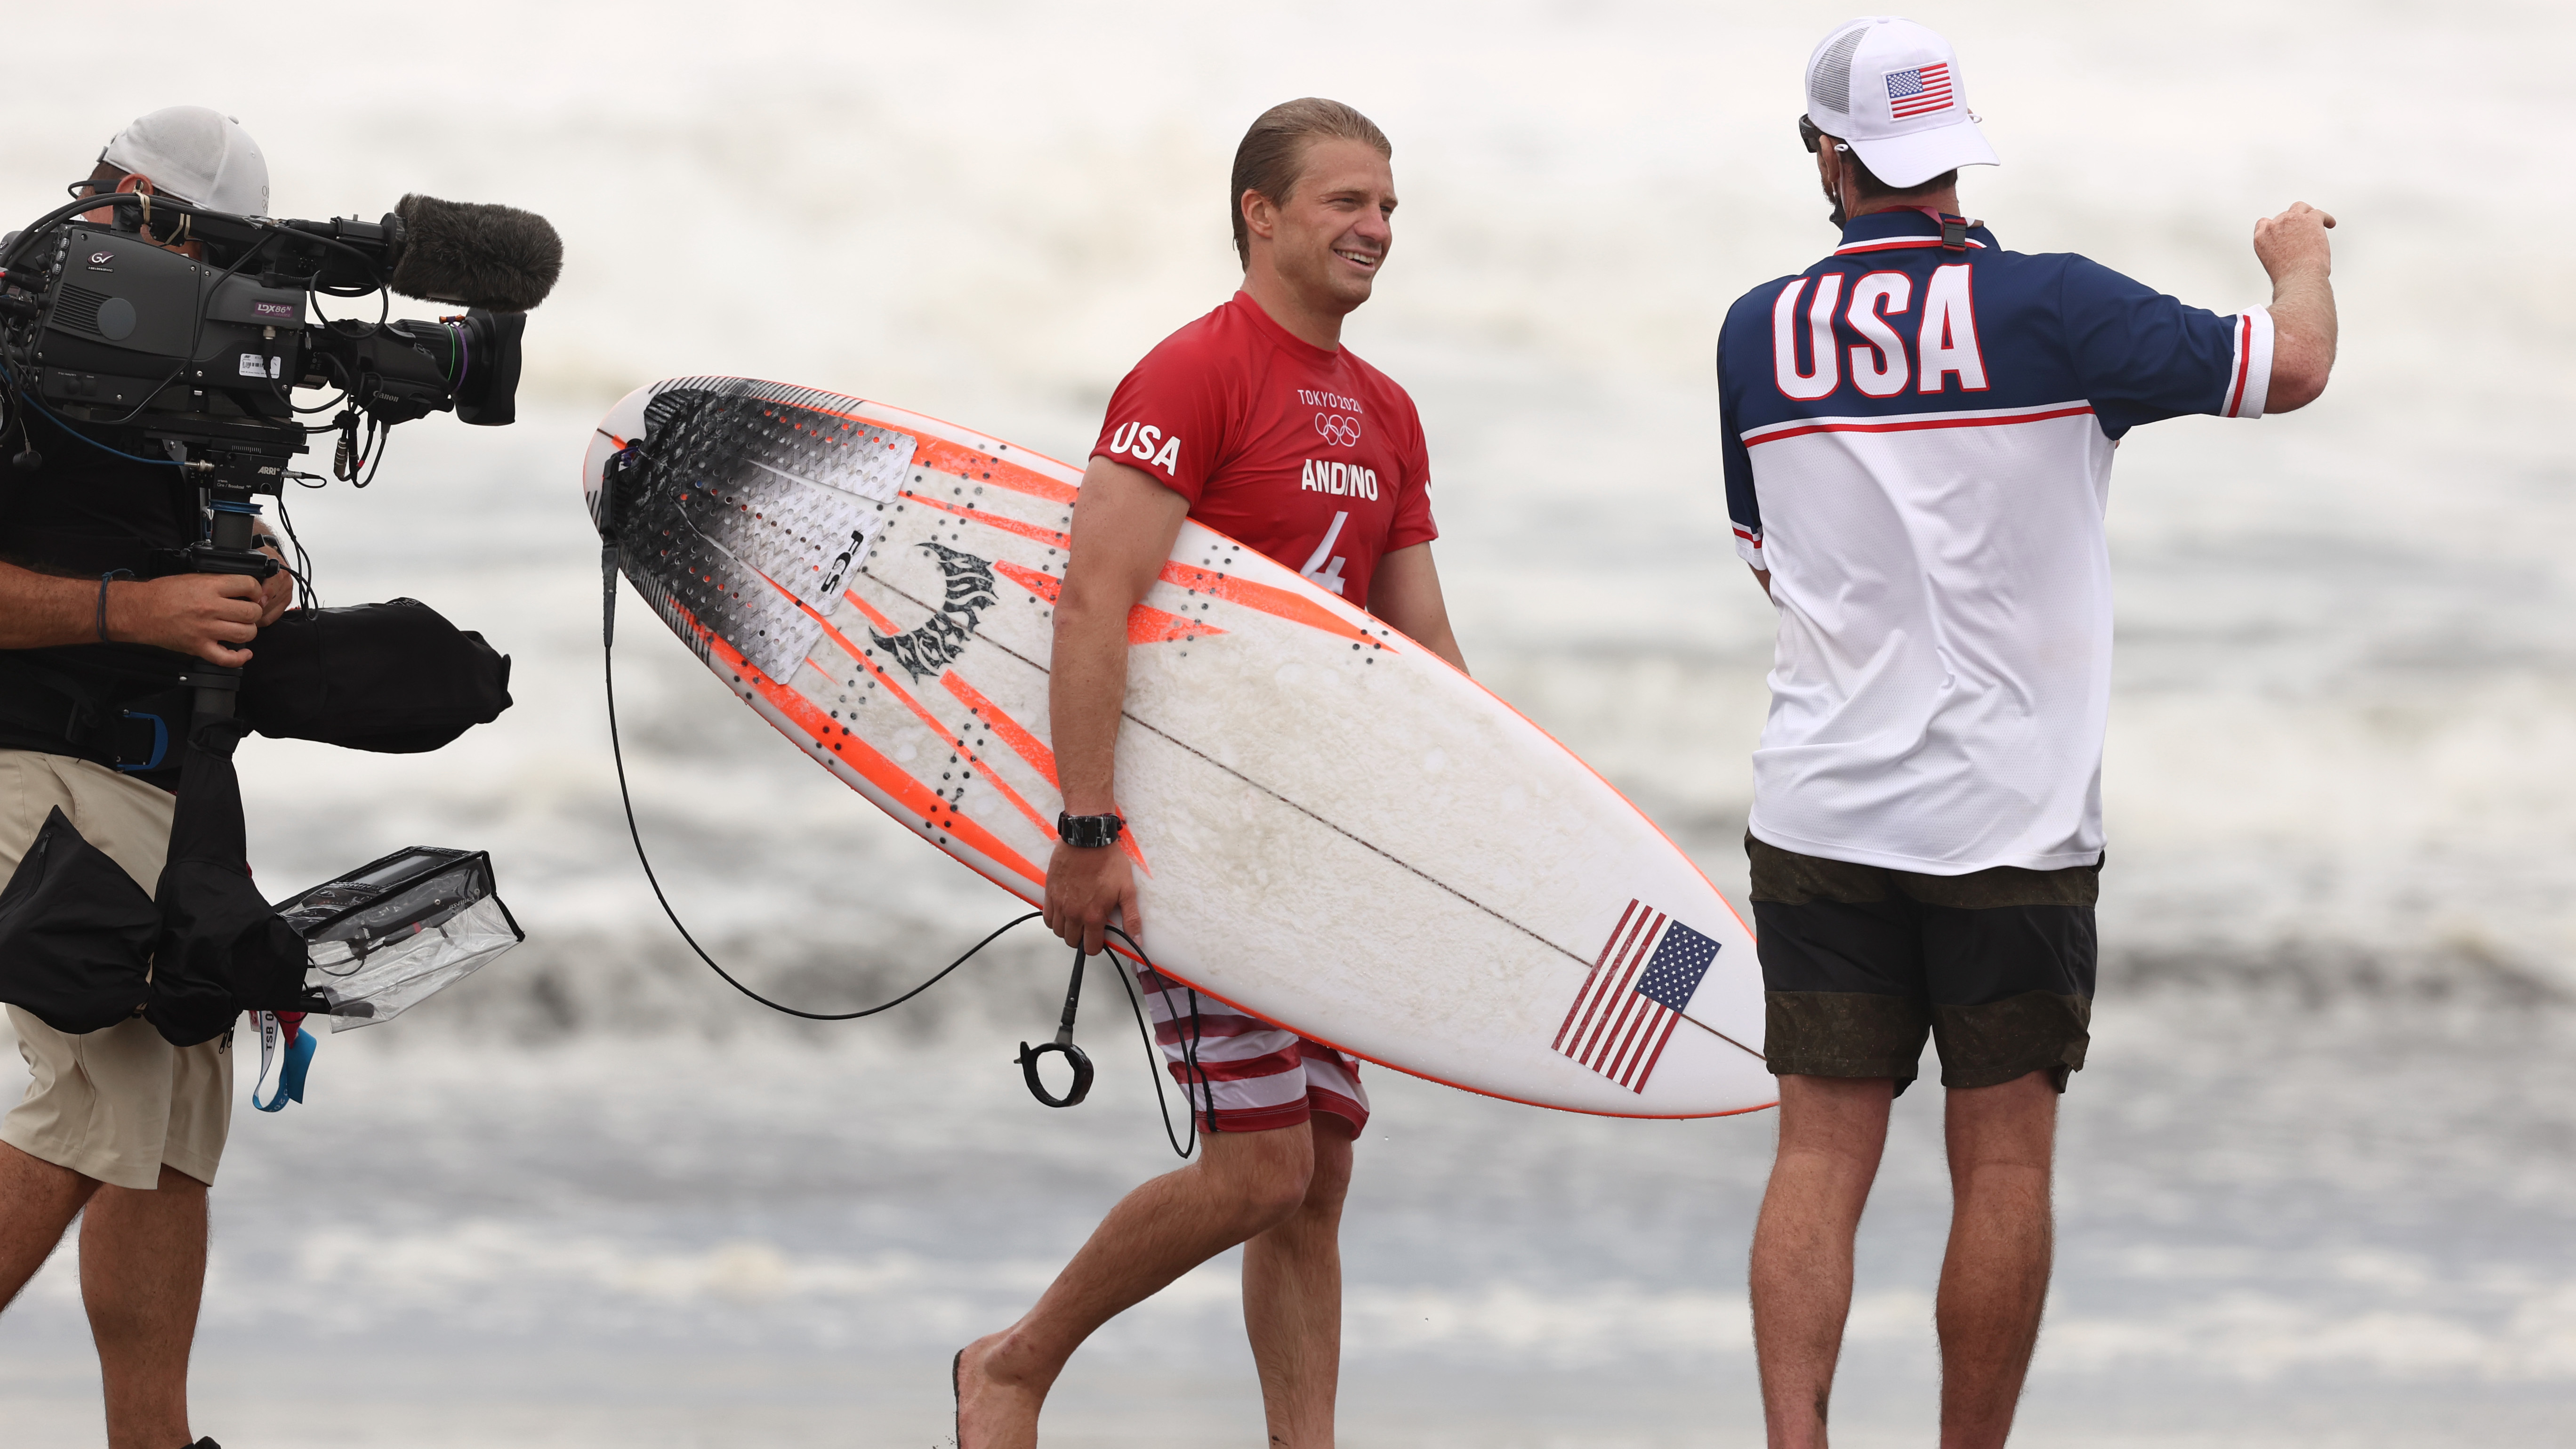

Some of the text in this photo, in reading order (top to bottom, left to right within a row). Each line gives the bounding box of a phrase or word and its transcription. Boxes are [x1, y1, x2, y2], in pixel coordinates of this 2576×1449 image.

[1772, 263, 1990, 402] USA
[373, 391, 399, 402] Canon
[1297, 389, 1363, 414] TOKYO 2020
[1110, 422, 1181, 476] USA
[1301, 459, 1378, 501] ANDINO
[821, 531, 863, 595] FCS
[1300, 511, 1349, 596] 4
[362, 927, 370, 939] ARRI
